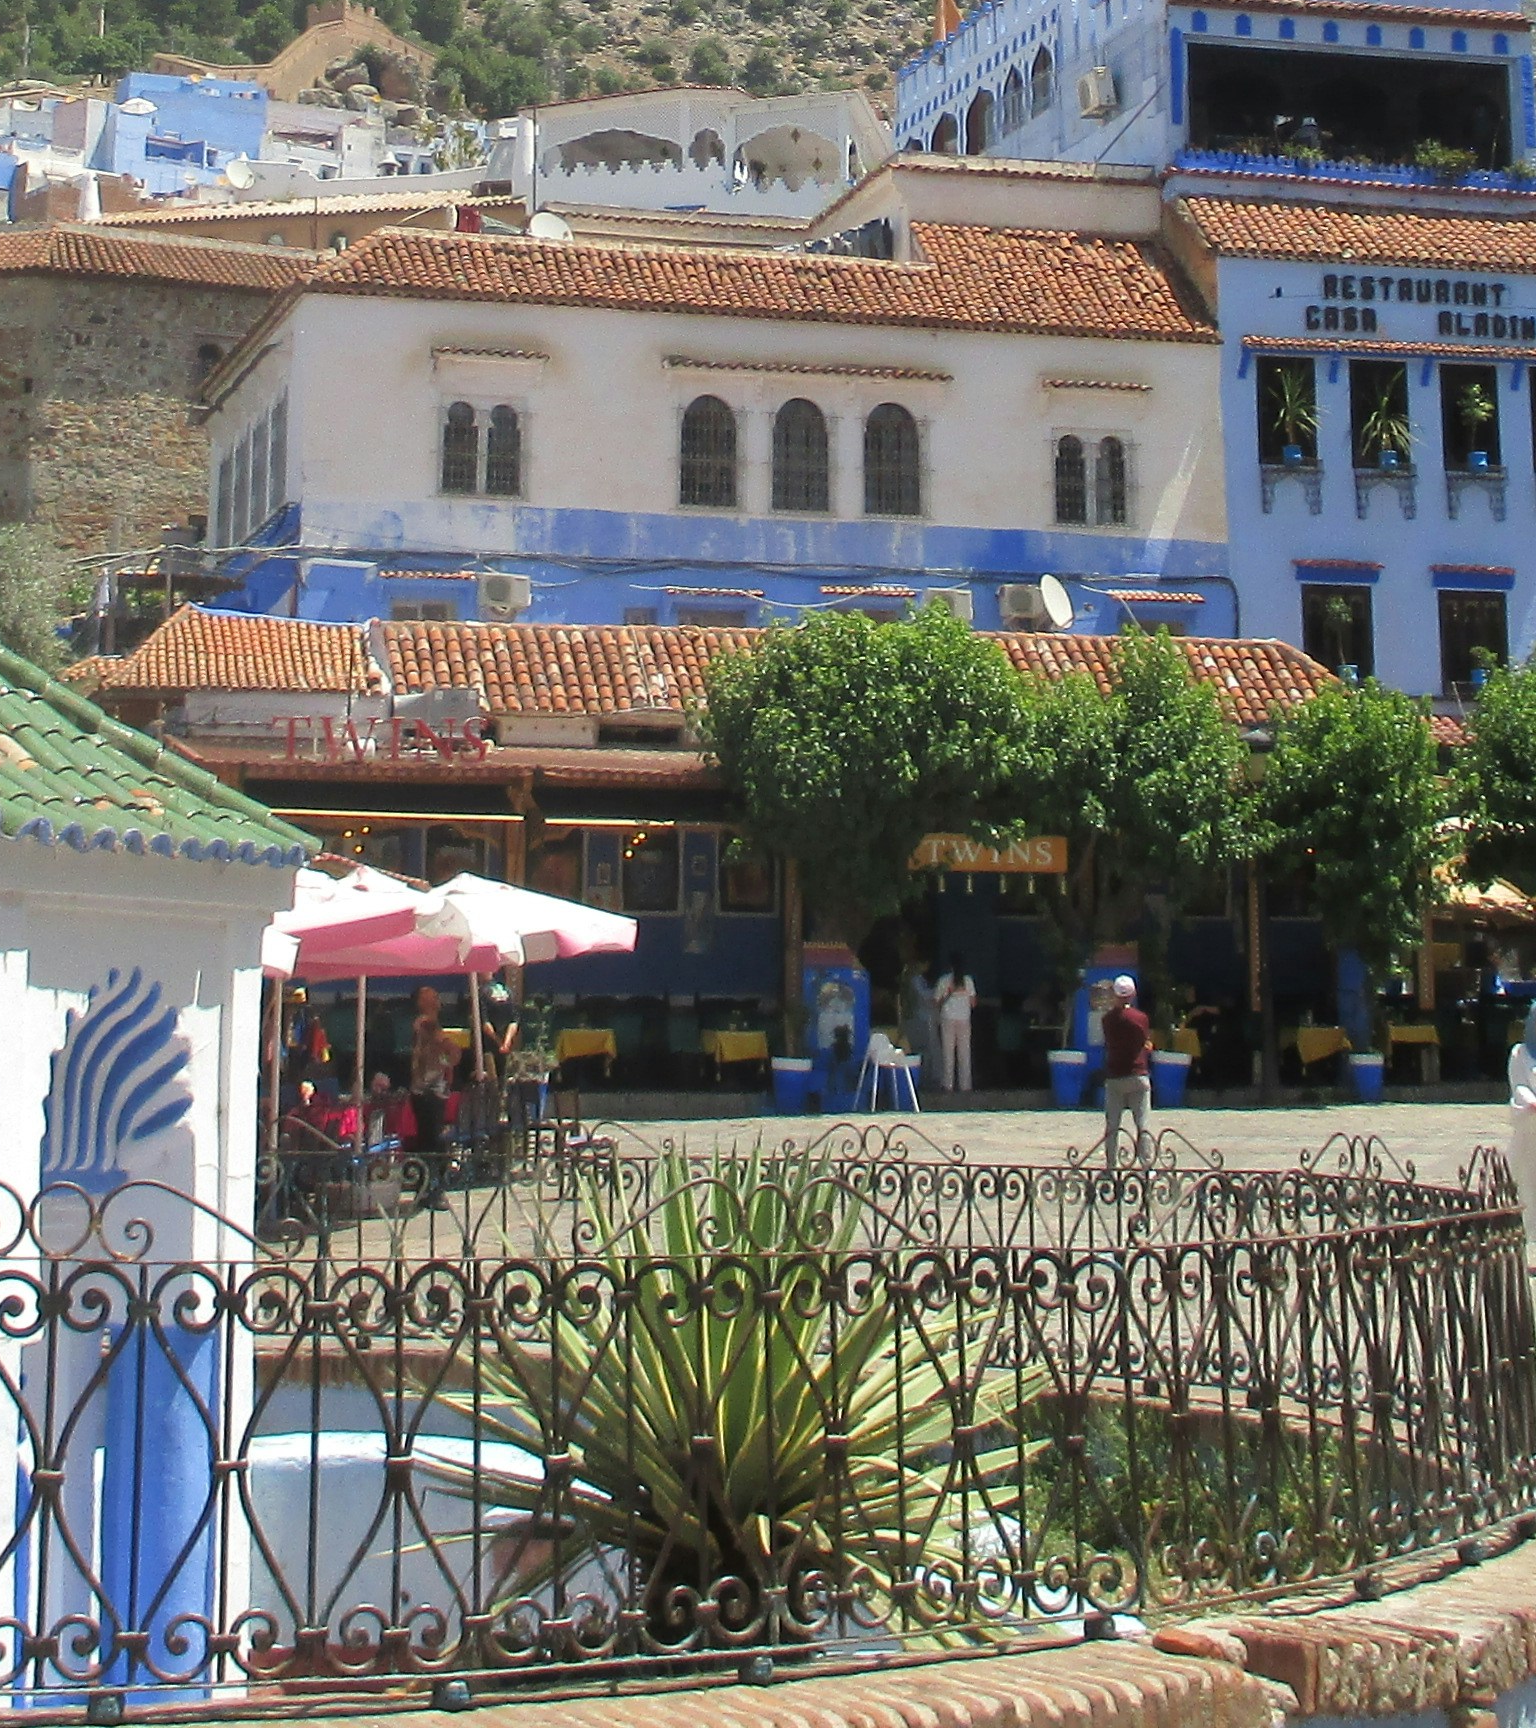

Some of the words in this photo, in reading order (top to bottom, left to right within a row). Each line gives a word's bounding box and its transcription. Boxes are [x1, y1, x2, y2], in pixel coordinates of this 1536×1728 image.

[1323, 274, 1505, 306] RESTAURANT
[1306, 305, 1377, 332] CASA
[1437, 310, 1536, 340] ALADIN
[271, 716, 490, 763] TWINS
[924, 838, 1053, 866] TWINS
